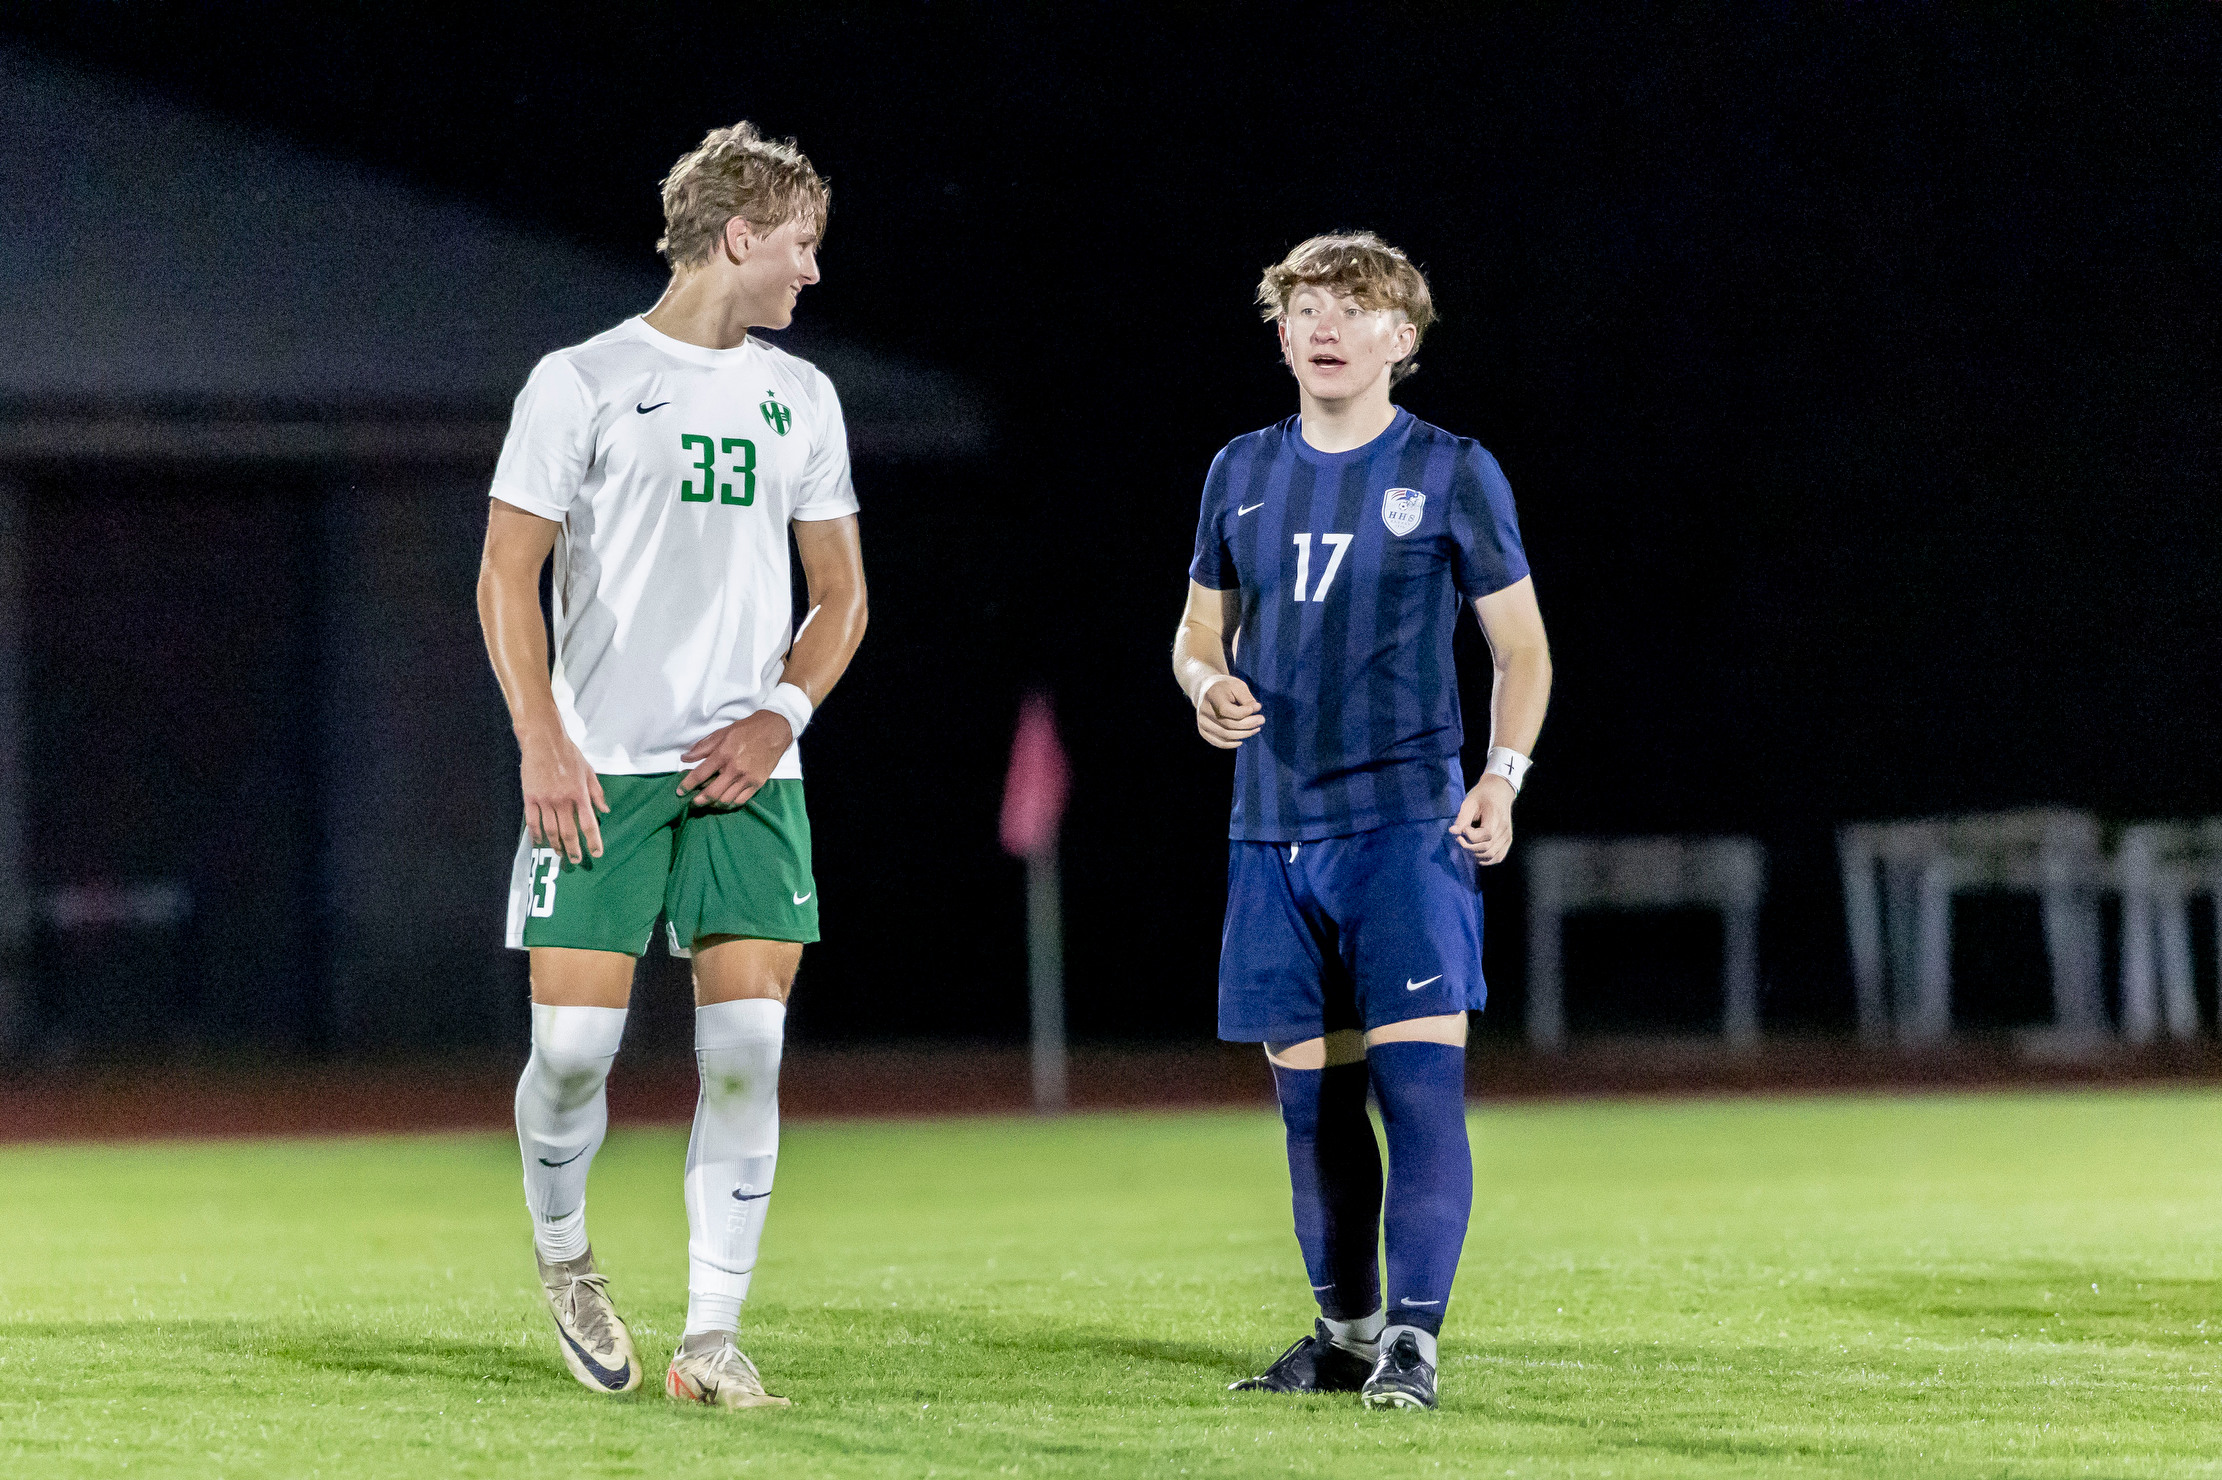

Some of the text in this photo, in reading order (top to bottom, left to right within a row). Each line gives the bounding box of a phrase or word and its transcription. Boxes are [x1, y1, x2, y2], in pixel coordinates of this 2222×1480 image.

[681, 433, 757, 507] 33
[1388, 511, 1416, 522] HHS
[1293, 533, 1354, 602] 17
